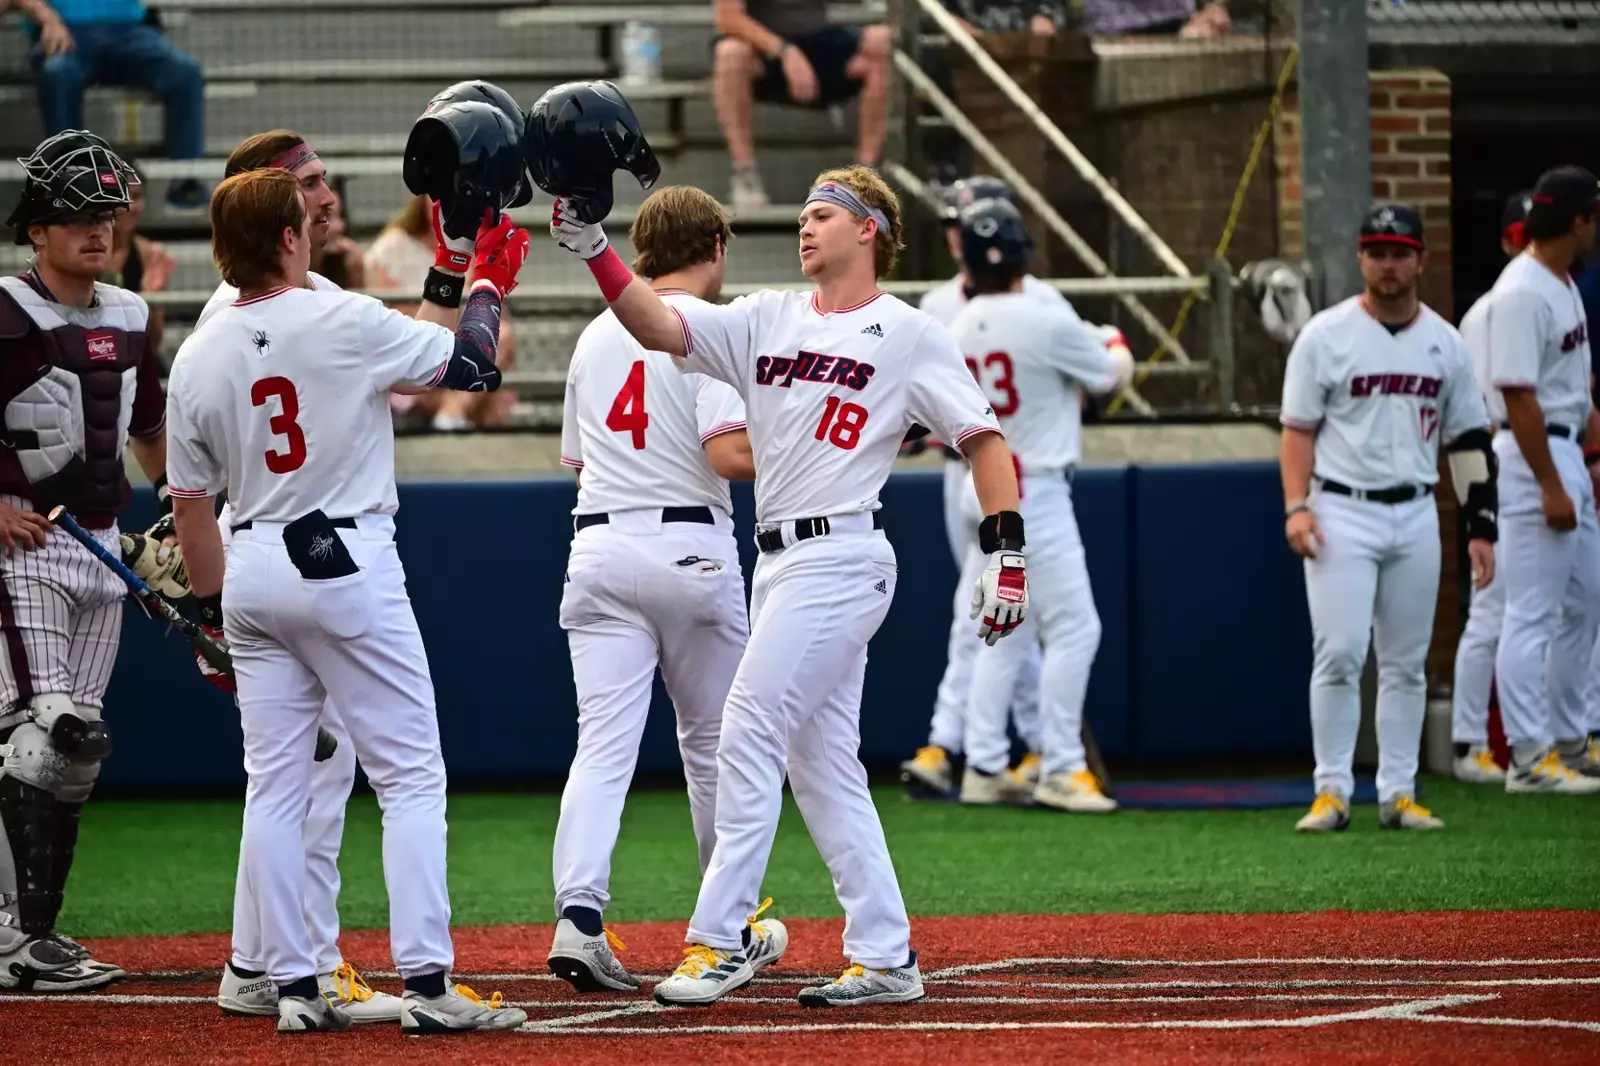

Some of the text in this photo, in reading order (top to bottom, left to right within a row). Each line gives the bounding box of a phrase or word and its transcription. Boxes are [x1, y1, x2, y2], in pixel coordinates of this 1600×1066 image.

[756, 350, 876, 391] SPIDERS
[965, 351, 1020, 418] 3
[250, 375, 307, 475] 3
[605, 359, 649, 451] 4
[814, 396, 869, 450] 18
[236, 980, 272, 996] ADIZERO
